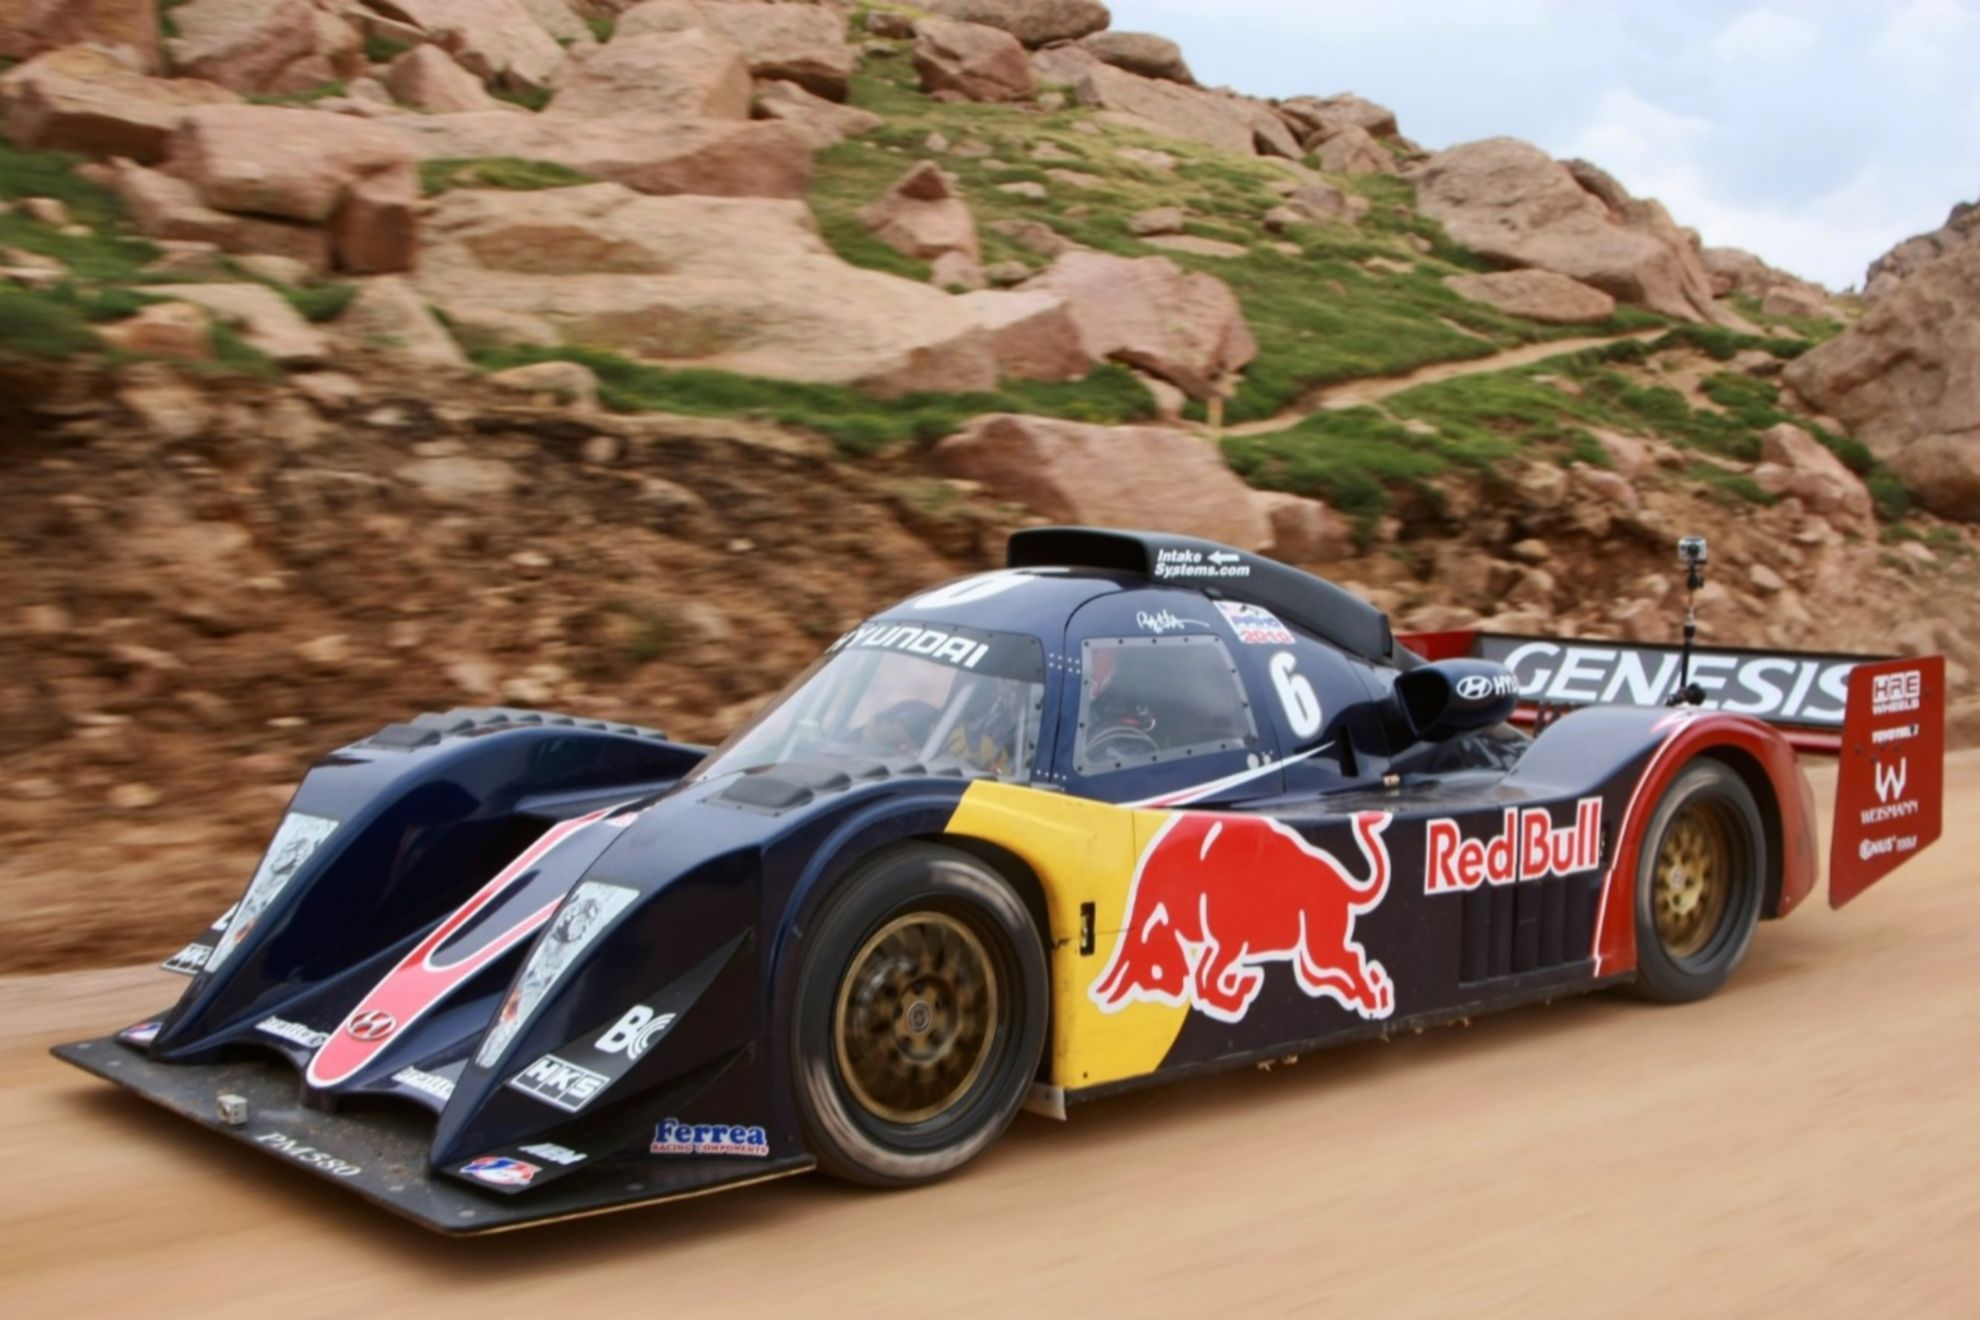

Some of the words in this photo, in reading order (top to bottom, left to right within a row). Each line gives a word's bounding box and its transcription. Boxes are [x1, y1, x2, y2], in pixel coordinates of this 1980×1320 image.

[1154, 562, 1250, 579] Systems.com
[1157, 549, 1202, 563] Intake
[1269, 651, 1322, 738] 6
[1503, 641, 1852, 722] GENESIS
[1873, 672, 1920, 702] HRE
[1425, 806, 1518, 895] Red
[1519, 796, 1603, 881] Bull
[524, 1057, 603, 1101] HKS
[654, 1118, 767, 1145] Ferrea
